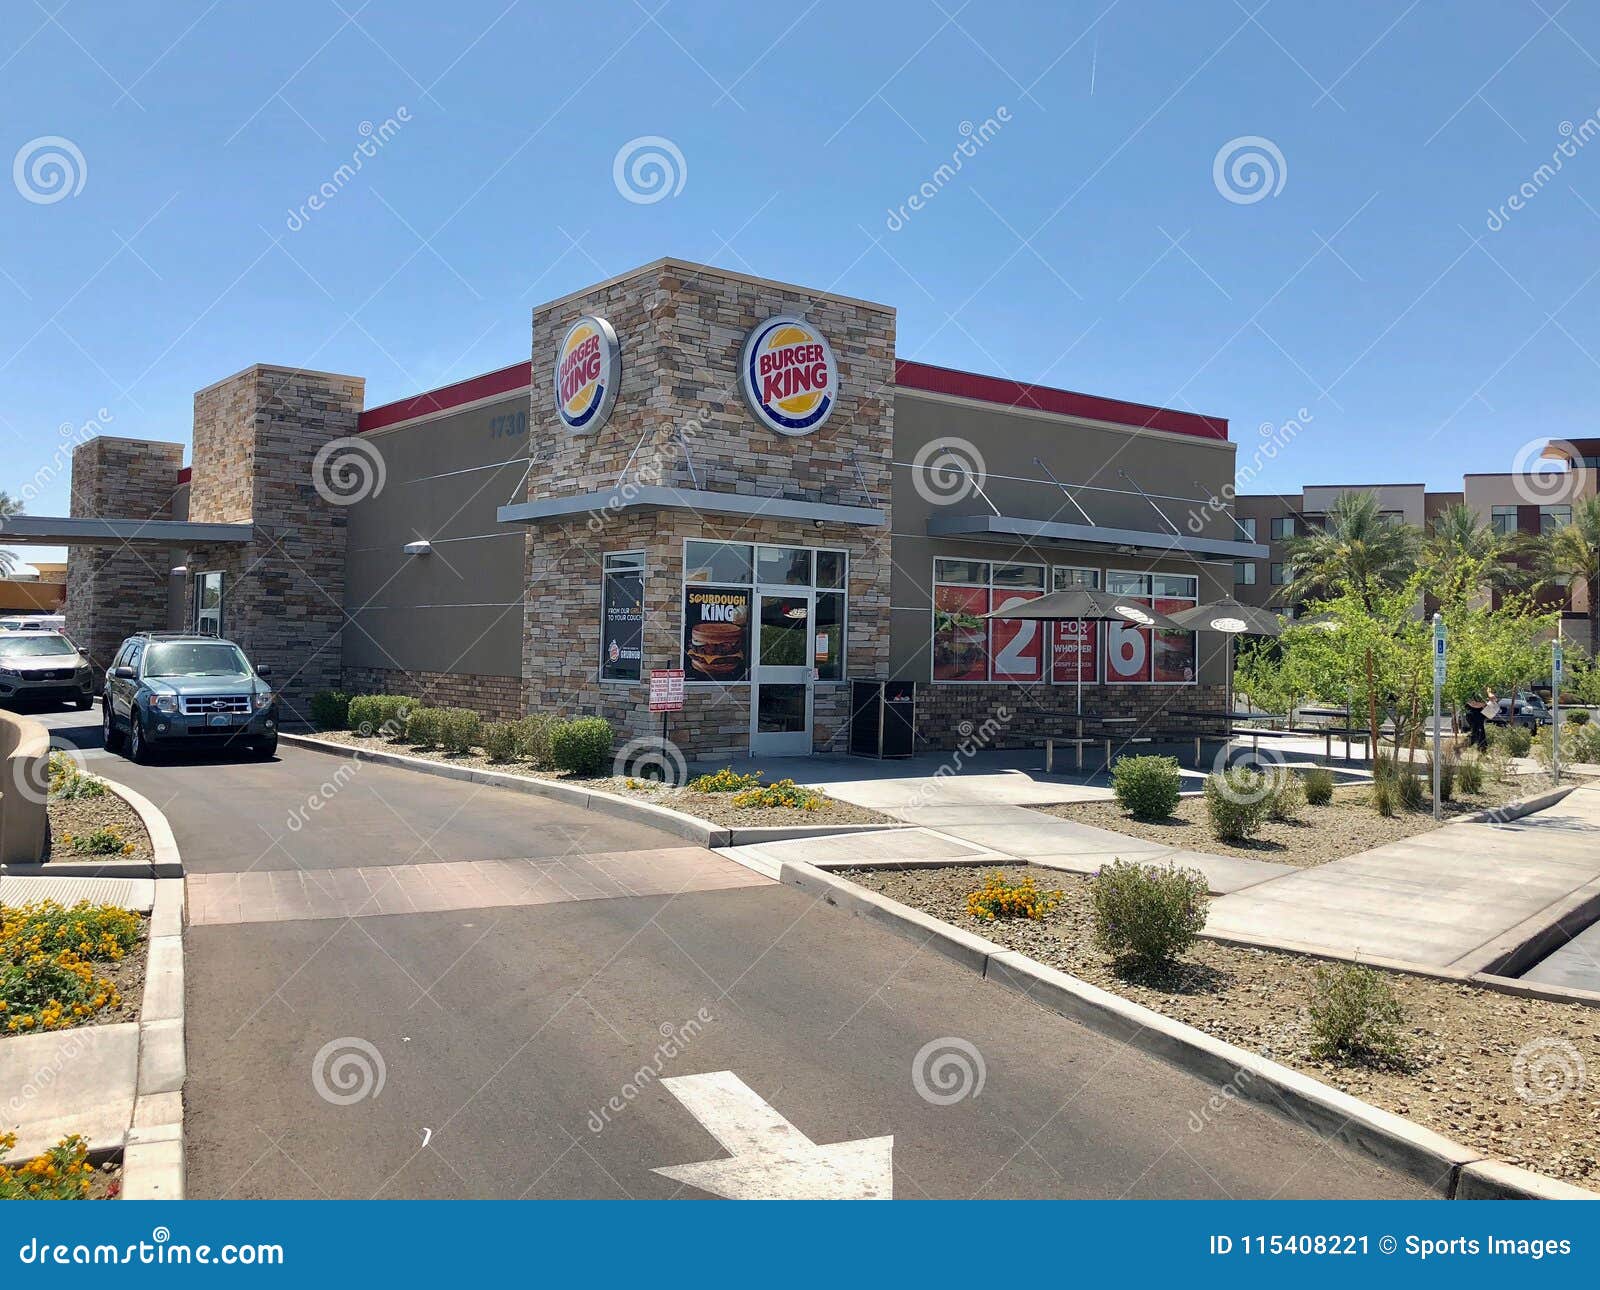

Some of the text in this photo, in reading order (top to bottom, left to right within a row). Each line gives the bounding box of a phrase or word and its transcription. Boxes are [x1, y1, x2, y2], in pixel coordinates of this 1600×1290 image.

[559, 334, 599, 382] BURGER
[759, 344, 825, 377] BURGER
[560, 352, 602, 410] KING
[762, 362, 828, 405] KING
[489, 409, 526, 439] 1730
[688, 594, 746, 605] SOURDOUGH
[995, 597, 1147, 676] 2 FOR 6
